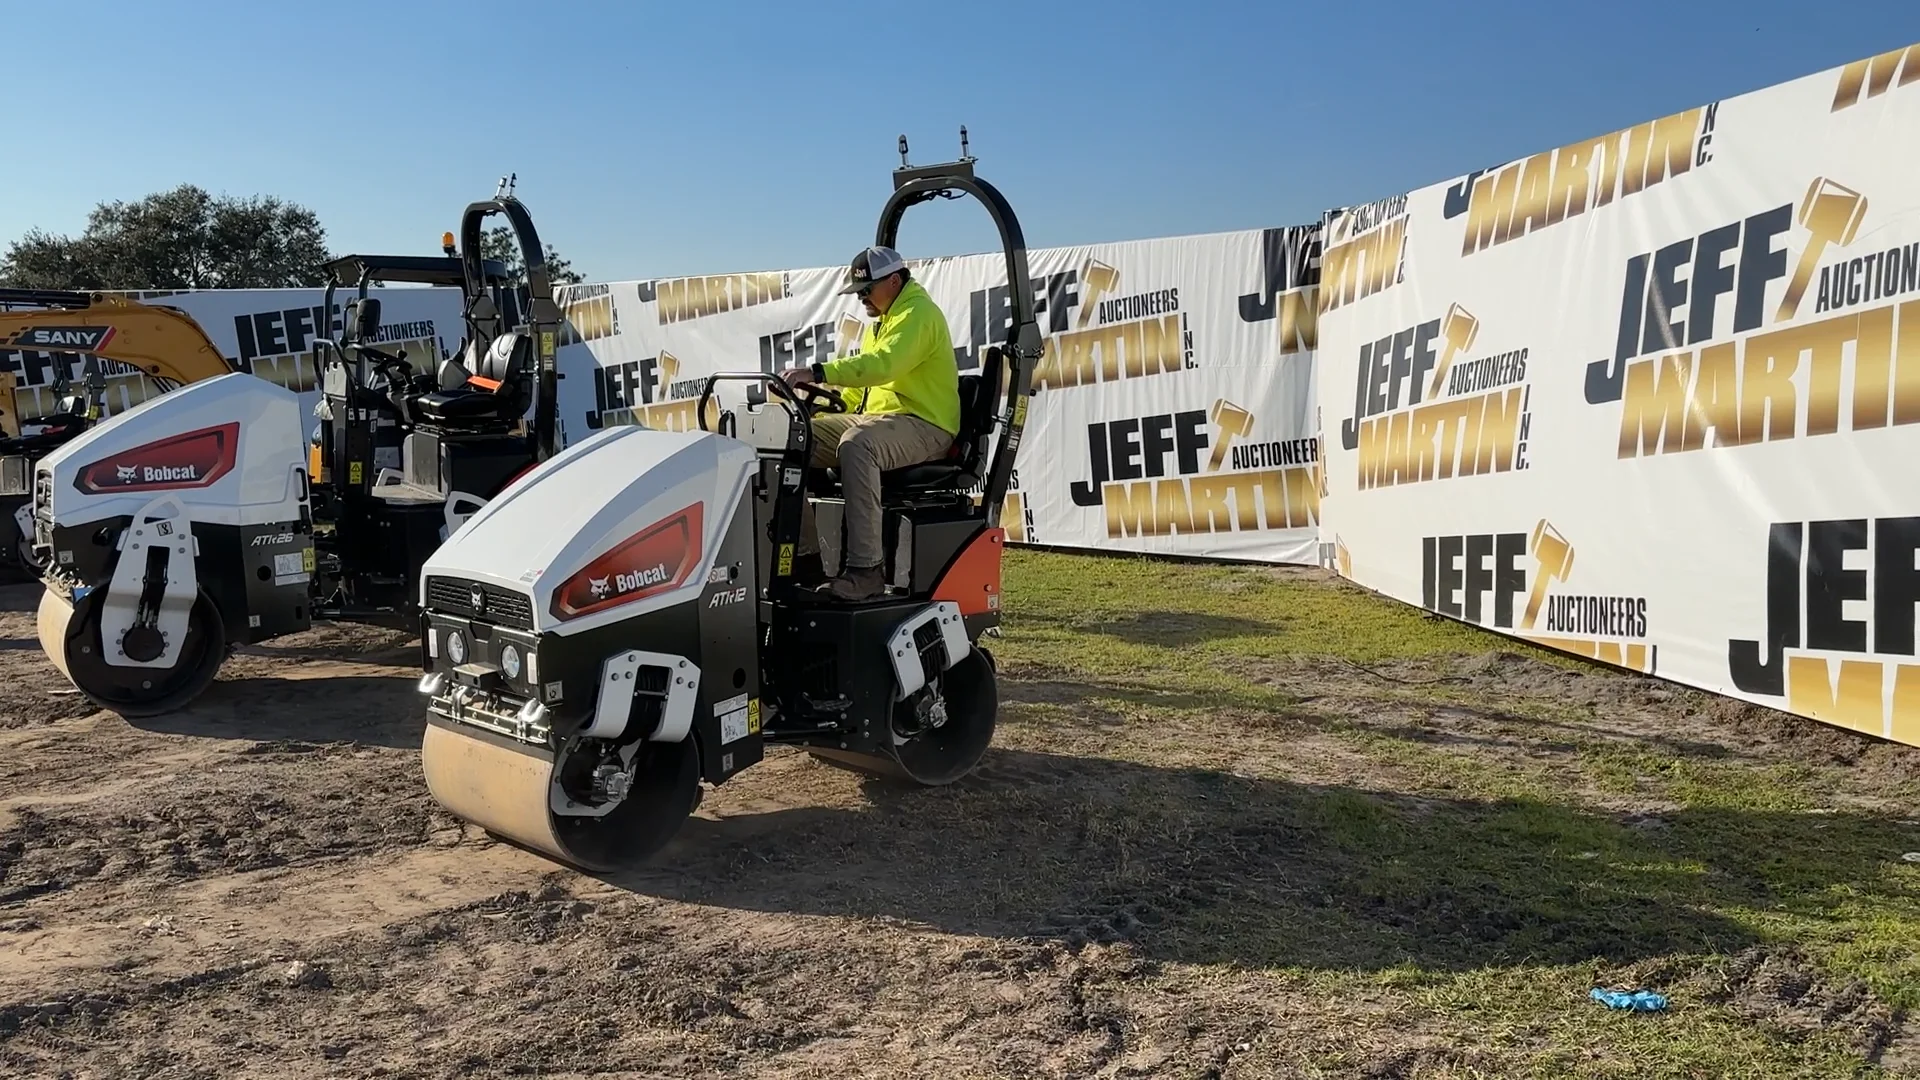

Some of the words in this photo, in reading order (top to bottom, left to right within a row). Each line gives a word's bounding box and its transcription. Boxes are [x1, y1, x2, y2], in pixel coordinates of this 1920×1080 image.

[1696, 101, 1720, 168] NC.
[1461, 107, 1701, 258] MARTIN
[657, 273, 783, 326] MARTIN
[1099, 288, 1179, 324] AUCTIONEERS
[1584, 202, 1793, 405] JEFF
[1815, 242, 1920, 314] AUCTION
[35, 330, 97, 344] SANY
[227, 304, 342, 374] JEFF
[367, 320, 435, 343] CTIONEERS
[1002, 314, 1181, 396] ARTIN
[1183, 312, 1199, 370] INC.
[586, 358, 658, 429] JEFF
[1342, 318, 1441, 450] JEFF
[1448, 348, 1529, 396] AUCTIONEERS
[1070, 409, 1209, 506] JEFF
[1232, 437, 1319, 470] AUCTIONEER
[1358, 387, 1522, 491] MARTIN
[1516, 384, 1531, 470] INC.
[144, 464, 196, 482] Bobcat
[1104, 466, 1320, 539] MARTIN
[615, 562, 667, 593] Bobcat
[1422, 532, 1527, 629] JEFF
[1729, 516, 1920, 697] JEF
[1547, 595, 1647, 638] AUCTIONEERS
